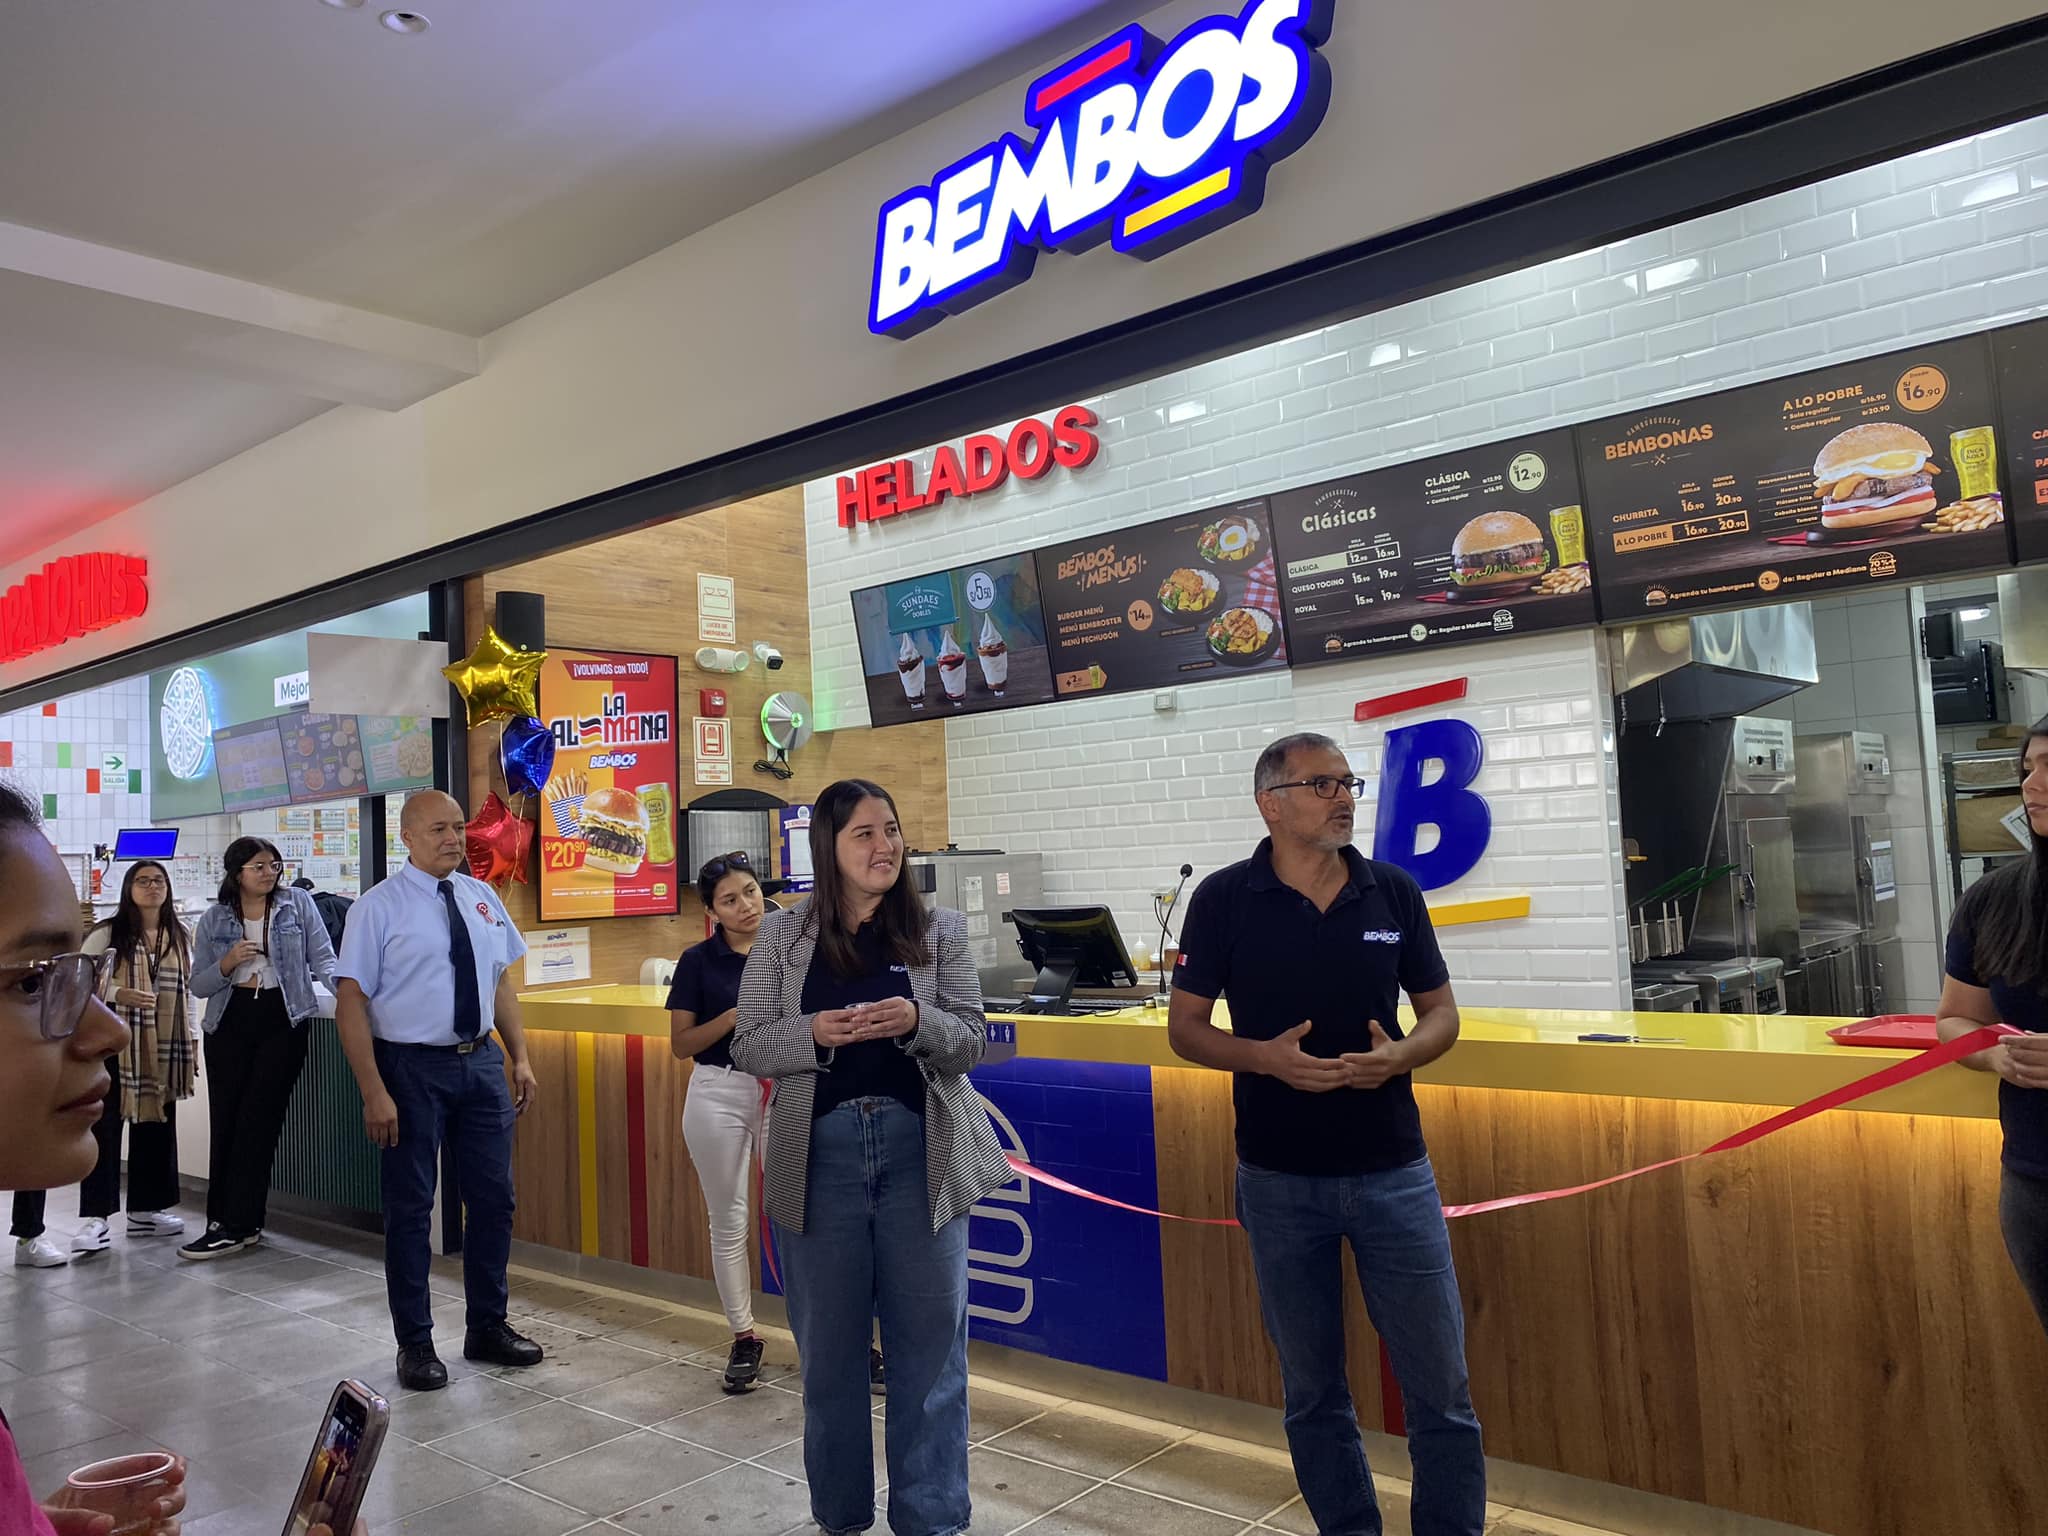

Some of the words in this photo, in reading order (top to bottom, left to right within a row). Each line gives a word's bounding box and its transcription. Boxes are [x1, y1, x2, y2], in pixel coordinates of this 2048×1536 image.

[876, 0, 1300, 323] BEMBOS
[1783, 401, 1793, 412] A
[1795, 396, 1813, 408] LO
[1816, 384, 1864, 403] POBRE
[1604, 423, 1714, 461] BEMBONAS
[836, 405, 1099, 529] HELADOS
[1301, 506, 1377, 533] Clásicas
[1612, 508, 1660, 523] CHURRITA
[1624, 537, 1636, 546] LO
[1637, 531, 1668, 543] POBRE
[1058, 544, 1115, 580] BEMBOS
[1086, 555, 1137, 589] MENÚS
[1291, 583, 1316, 594] QUESO
[1317, 578, 1345, 590] TOCINO
[901, 594, 939, 611] SUNDAES
[1294, 604, 1318, 615] ROYAL
[627, 661, 649, 675] TODO!
[603, 695, 625, 717] LA
[589, 752, 637, 770] BEMBOS
[1373, 718, 1492, 891] B
[1363, 930, 1401, 943] BEMBOS
